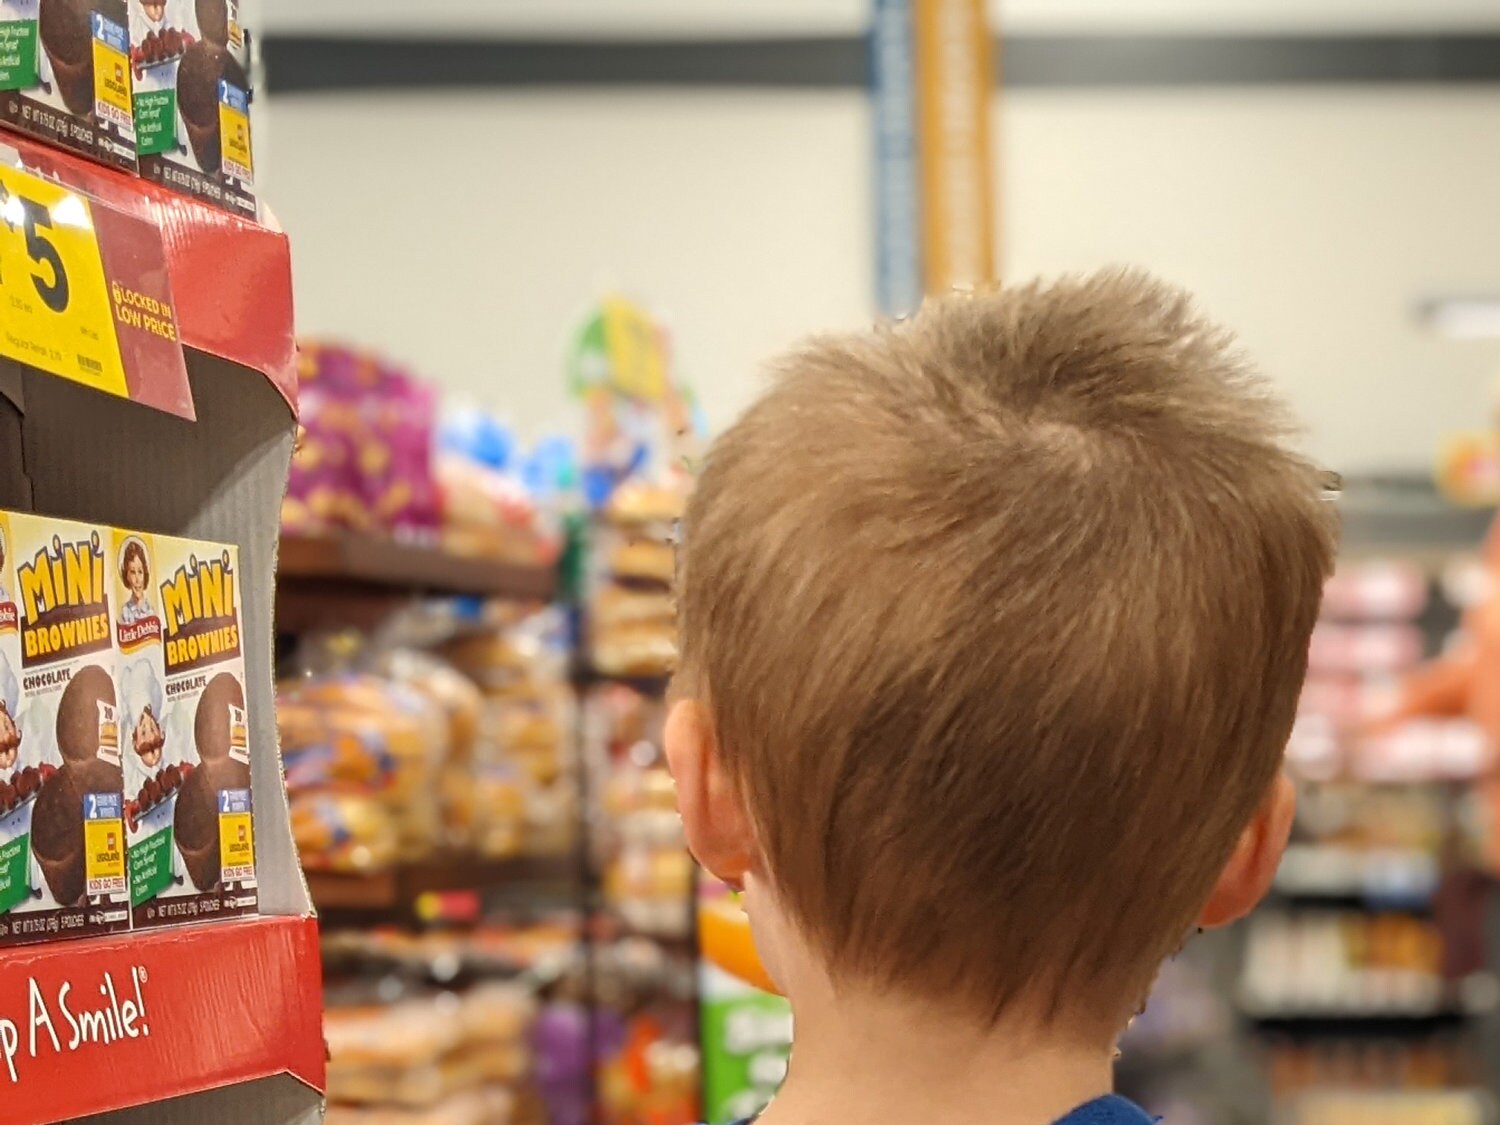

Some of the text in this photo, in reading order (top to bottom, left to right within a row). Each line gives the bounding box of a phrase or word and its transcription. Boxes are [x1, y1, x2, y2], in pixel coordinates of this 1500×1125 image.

[19, 194, 69, 313] 5
[115, 303, 177, 341] LOW PRICE
[120, 288, 172, 319] LOCKED IN
[24, 612, 109, 658] BROWNIES
[118, 619, 159, 643] Little Debbie
[166, 623, 239, 666] BROWNIES
[23, 667, 72, 691] CHOCOLATE
[165, 675, 207, 696] CHOCOLATE
[0, 965, 150, 1083] p A Smile!
